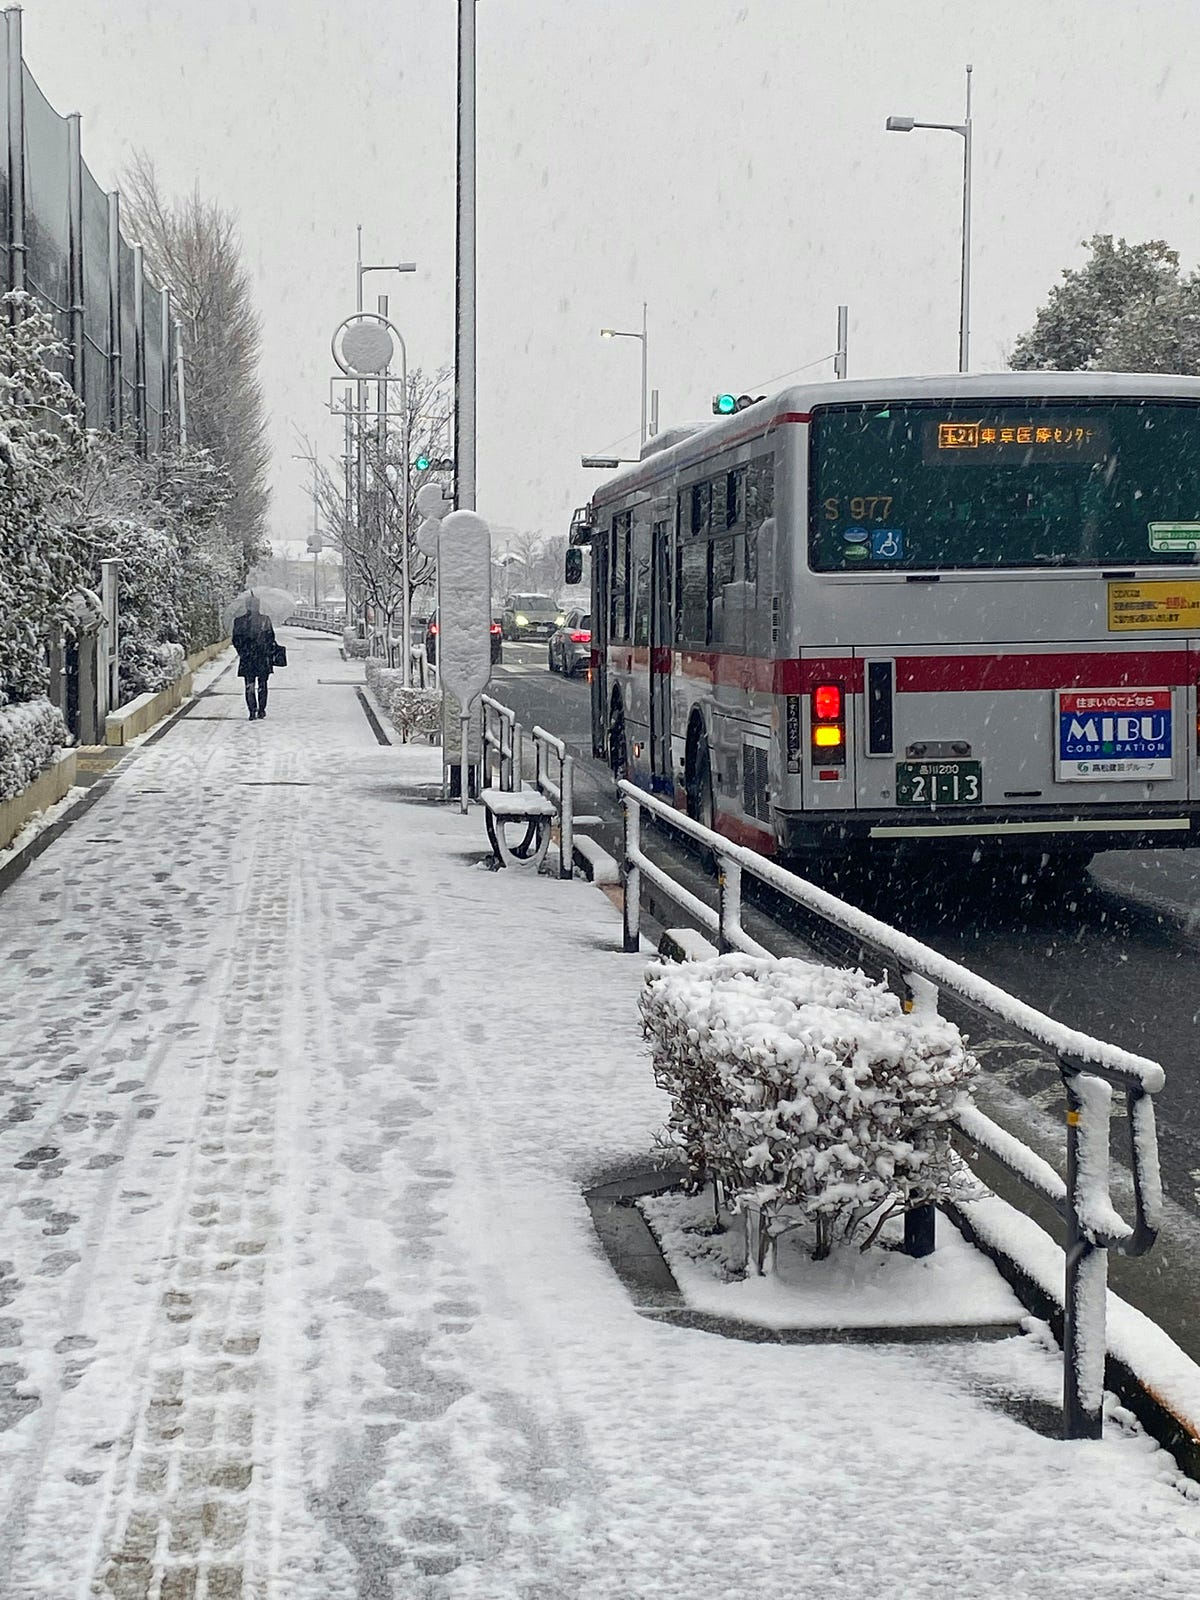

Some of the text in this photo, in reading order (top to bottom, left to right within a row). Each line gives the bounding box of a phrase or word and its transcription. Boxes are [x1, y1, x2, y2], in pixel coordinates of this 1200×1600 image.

[823, 496, 893, 520] S 977
[1076, 695, 1155, 708] 住まいのことなら
[1066, 716, 1164, 742] MIBU
[911, 775, 978, 801] 21-13
